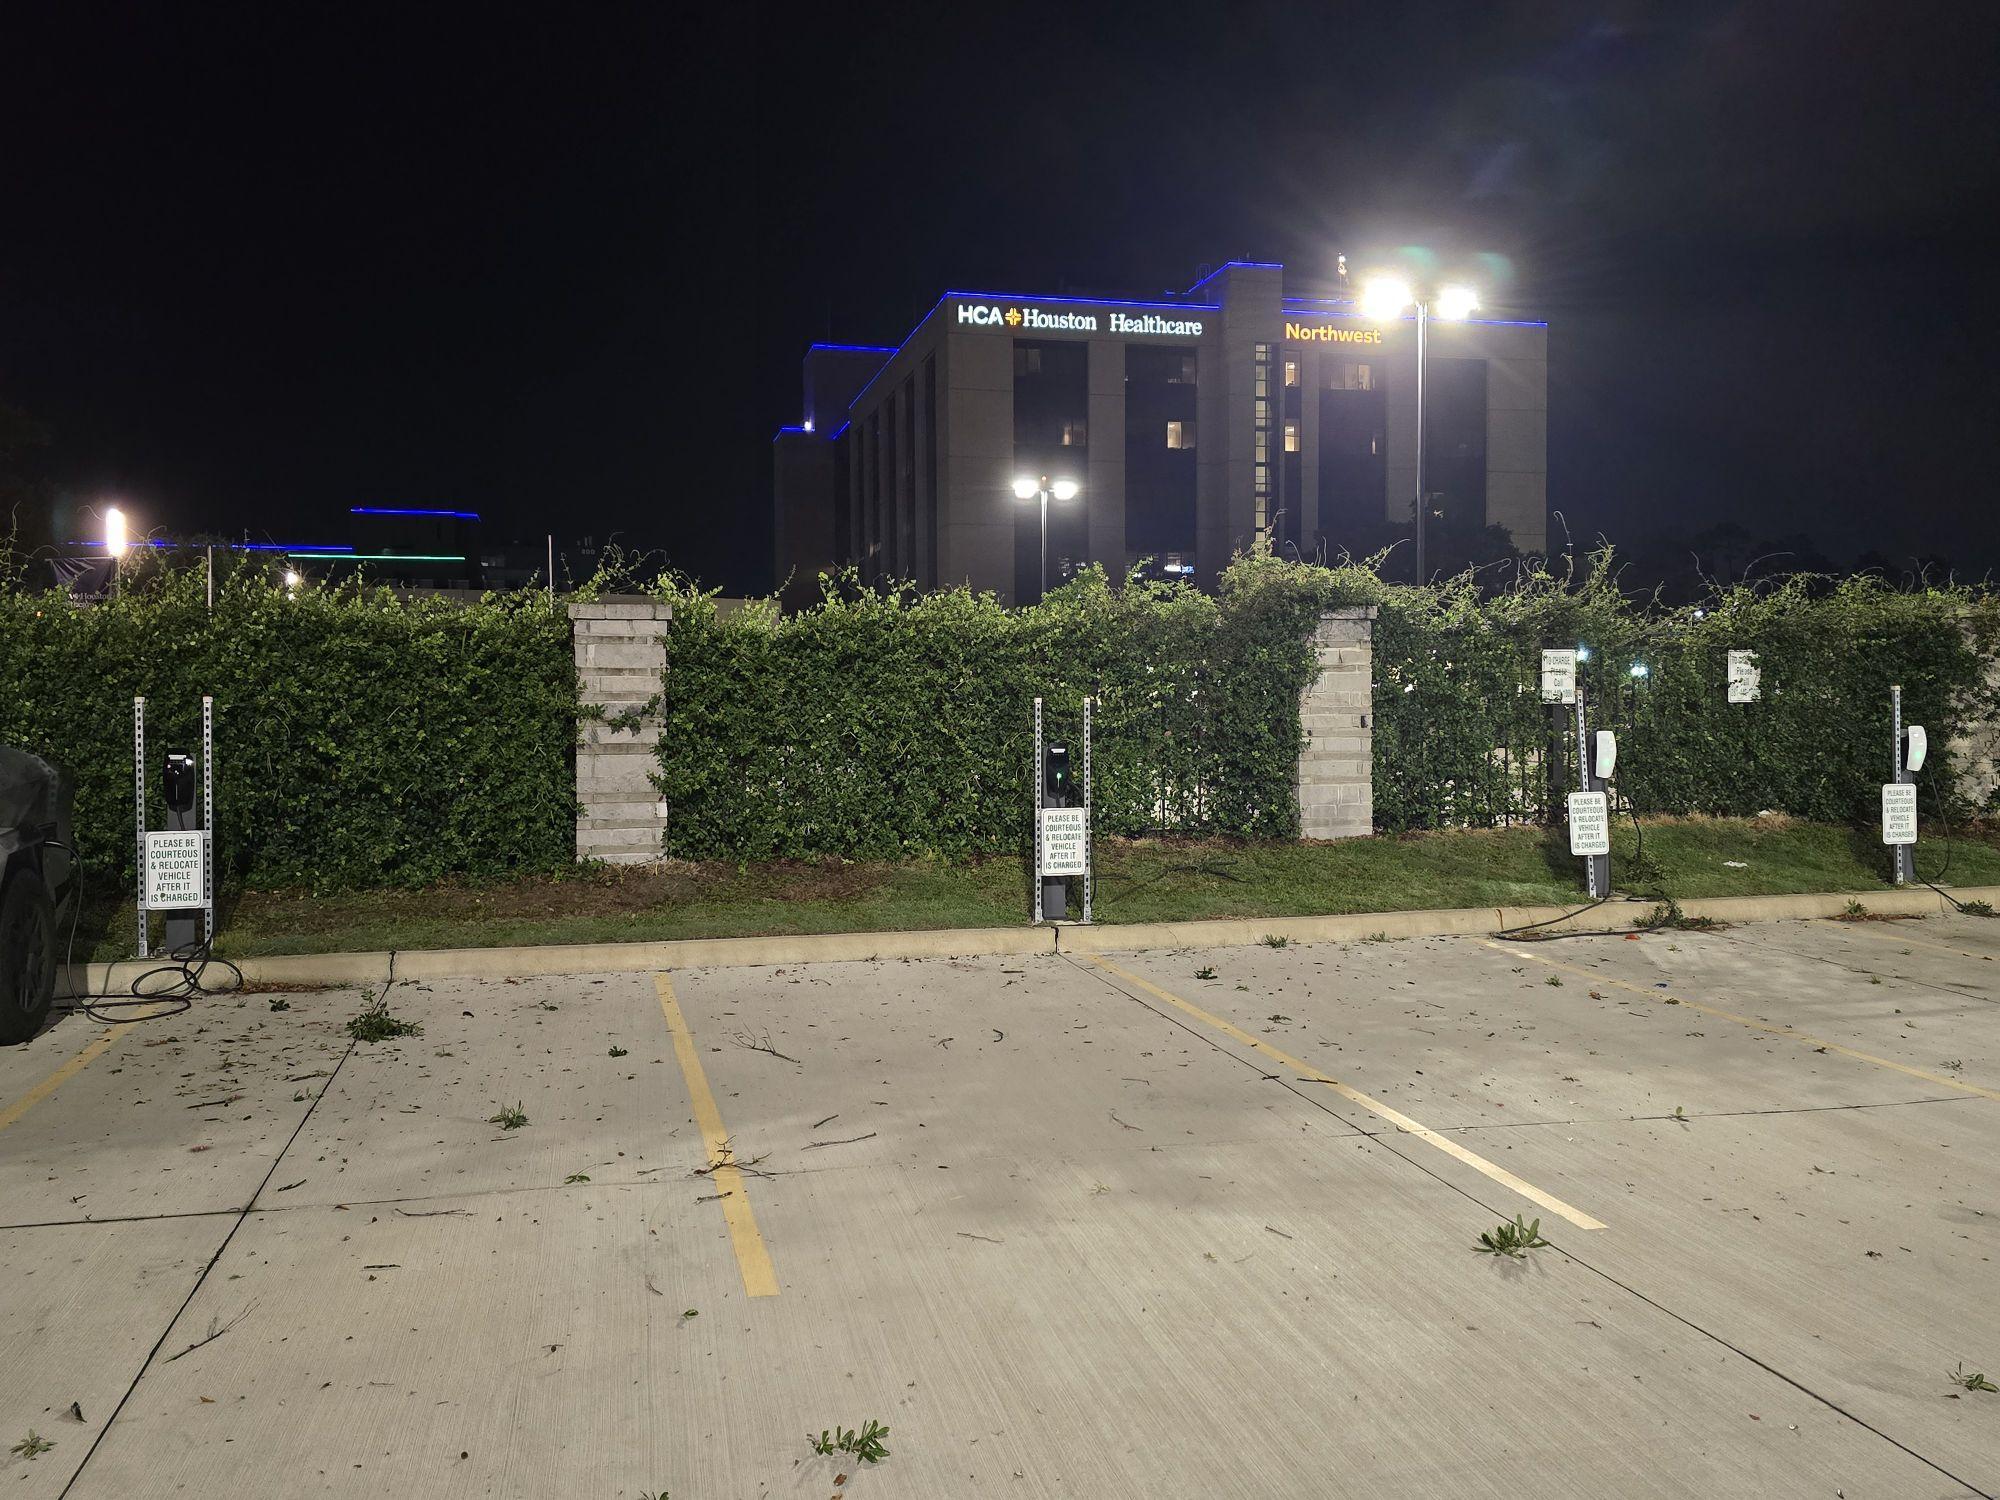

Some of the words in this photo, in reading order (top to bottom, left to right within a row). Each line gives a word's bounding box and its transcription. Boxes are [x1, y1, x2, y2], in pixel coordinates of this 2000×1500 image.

[957, 304, 1004, 325] HCA
[1022, 308, 1098, 331] Houston
[1109, 312, 1203, 335] Healthcare
[1285, 322, 1382, 344] Northwest
[1887, 789, 1905, 797] PLEASE
[1573, 797, 1593, 806] PLEASE
[1594, 797, 1601, 805] BE
[1885, 797, 1914, 805] COURTEOUS
[1572, 806, 1604, 815] COURTEOUS
[1890, 805, 1915, 814] RELOCATE
[1047, 815, 1070, 823] PLEASE
[1071, 814, 1080, 822] BE
[1578, 815, 1604, 823] RELOCATE
[1890, 814, 1910, 822] VEHICLE
[1045, 823, 1082, 832] COURTEOUS
[1578, 823, 1600, 832] VEHICLE
[1889, 822, 1904, 830] AFTER
[1045, 833, 1050, 841] &
[1051, 832, 1082, 841] RELOCATE
[1577, 833, 1595, 841] AFTER
[1595, 832, 1600, 840] IT
[1891, 830, 1914, 839] CHARGED
[153, 839, 184, 848] PLEASE
[185, 838, 196, 847] BE
[1051, 842, 1076, 850] VEHICLE
[1581, 841, 1606, 850] CHARGED
[150, 849, 198, 859] COURTEOUS
[1049, 852, 1069, 860] AFTER
[1070, 852, 1076, 860] IT
[150, 861, 156, 870] &
[158, 860, 199, 870] RELOCATE
[1045, 862, 1052, 870] IS
[1053, 861, 1082, 869] CHARGED
[158, 871, 191, 881] VEHICLE
[156, 882, 181, 892] AFTER
[183, 882, 191, 891] IT
[150, 893, 159, 902] IS
[160, 892, 198, 902] CHARGED
